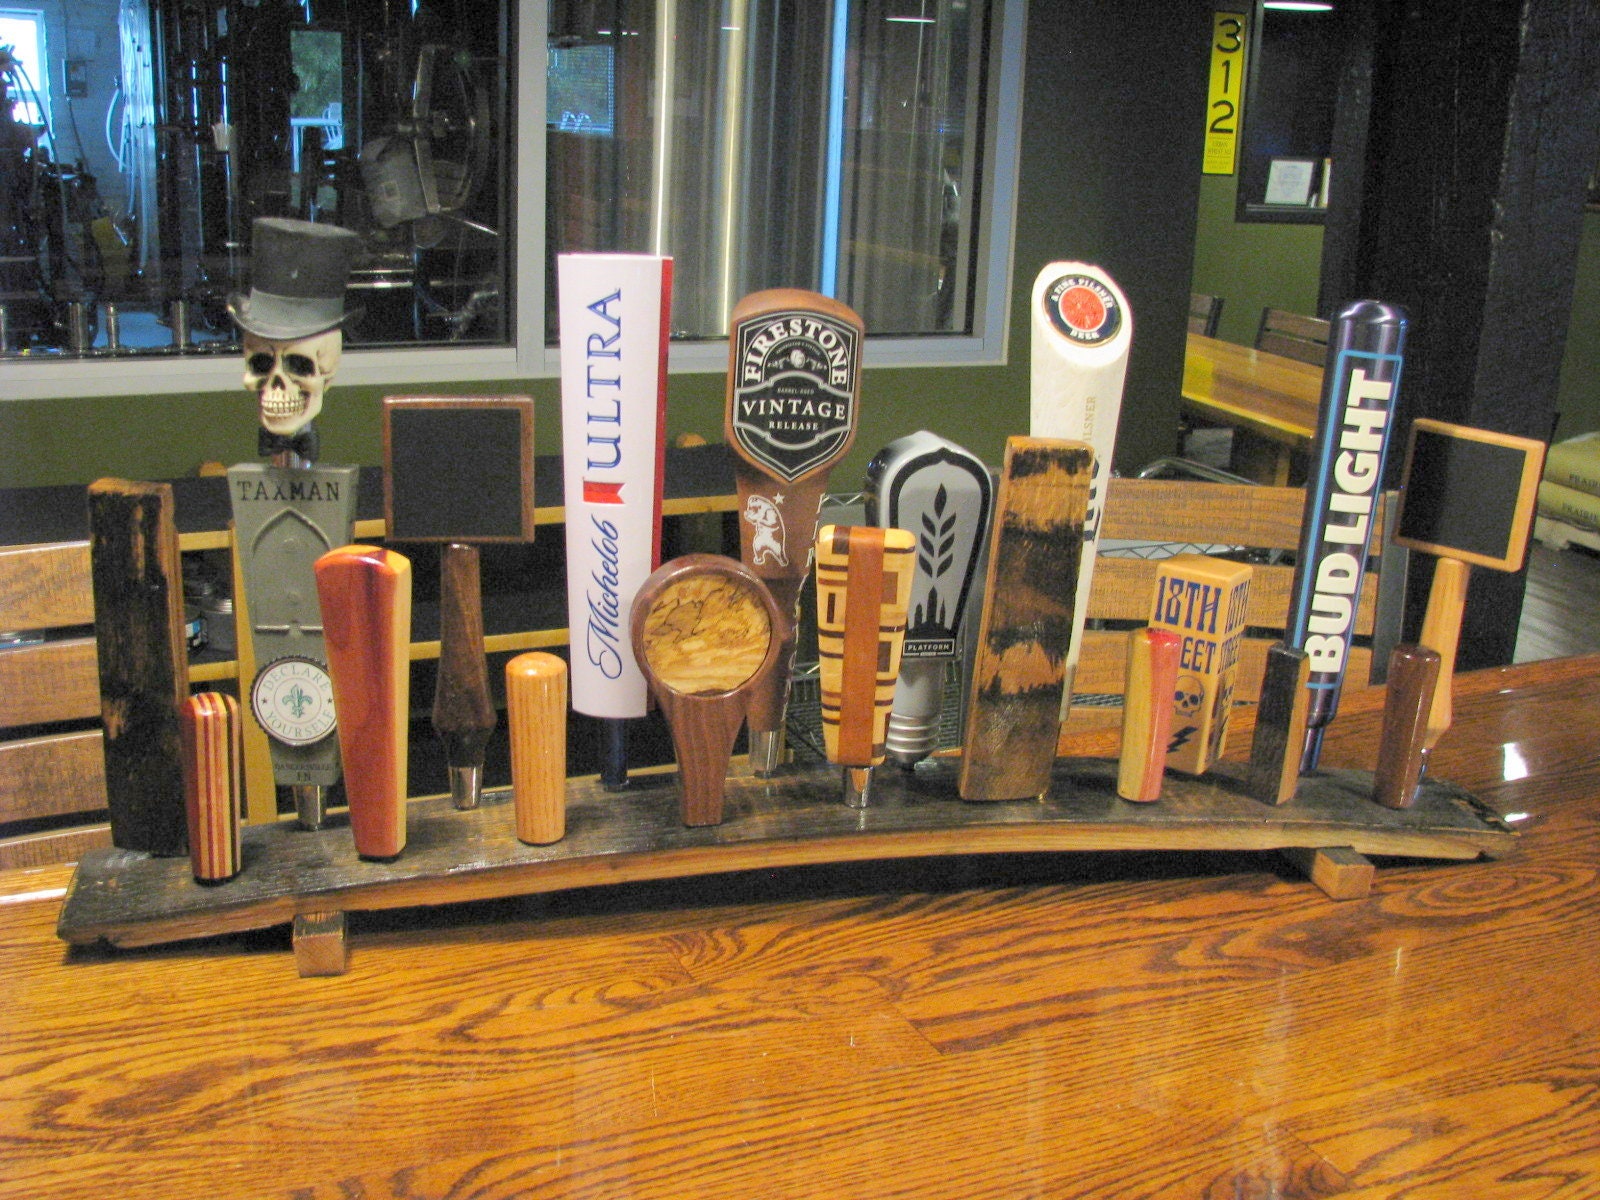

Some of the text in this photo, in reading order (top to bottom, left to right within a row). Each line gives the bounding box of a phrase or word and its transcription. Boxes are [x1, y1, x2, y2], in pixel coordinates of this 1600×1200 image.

[1209, 18, 1242, 134] 312
[1078, 278, 1114, 309] PILSNER
[744, 318, 848, 386] FIRESTONE
[741, 399, 846, 421] VINTAGE
[768, 421, 819, 431] RELEASE
[1081, 395, 1097, 441] ILSNER
[237, 480, 340, 501] TAXMAN
[586, 287, 623, 680] Michelob ULTRA
[1304, 368, 1392, 673] BUD LIGHT
[1154, 576, 1222, 634] 18TH
[907, 643, 950, 651] PLATFORM
[1179, 636, 1217, 675] EET
[262, 664, 331, 691] DECLARE
[265, 710, 334, 738] YOURSELF
